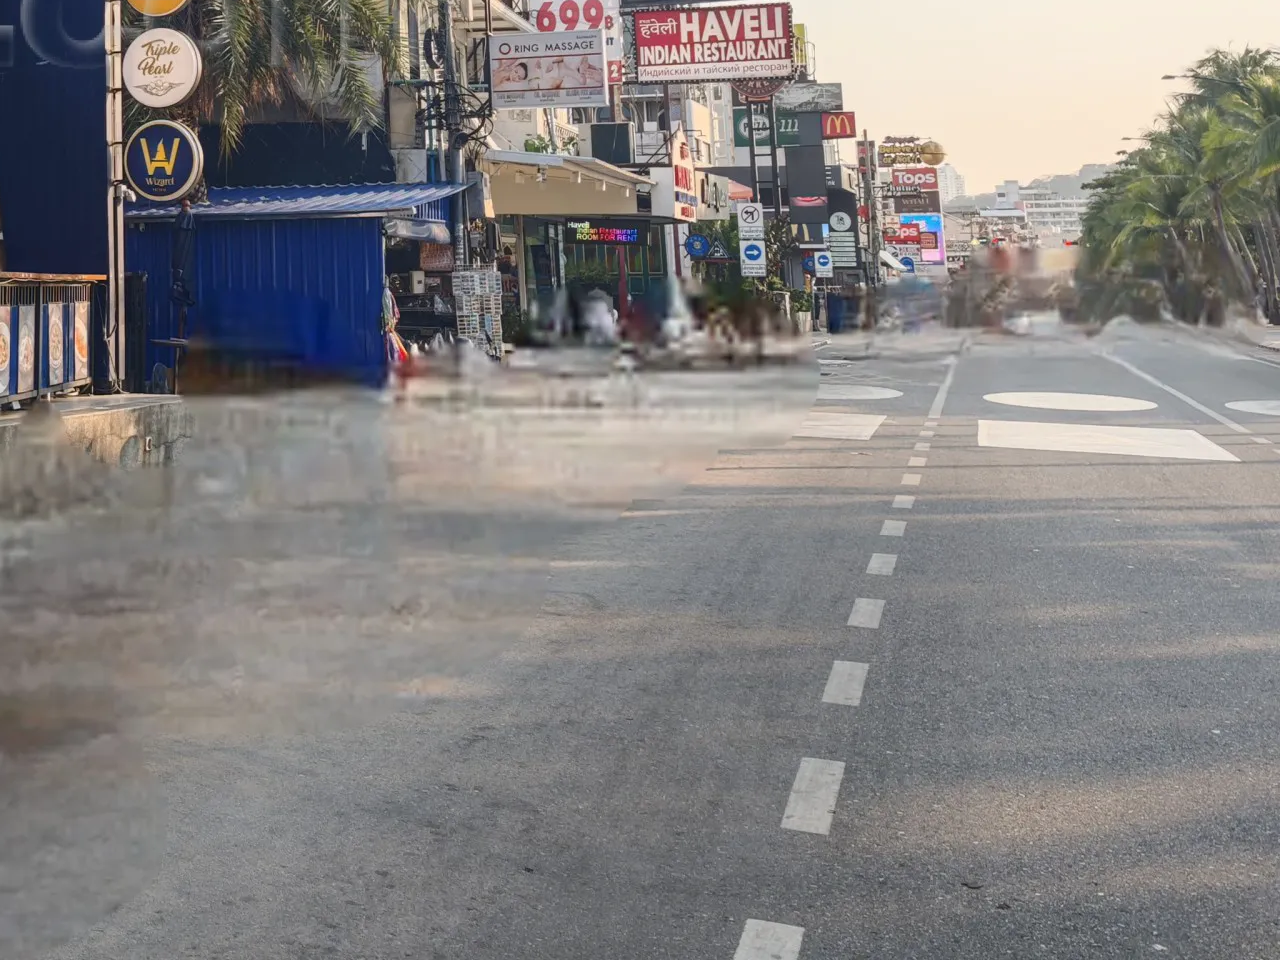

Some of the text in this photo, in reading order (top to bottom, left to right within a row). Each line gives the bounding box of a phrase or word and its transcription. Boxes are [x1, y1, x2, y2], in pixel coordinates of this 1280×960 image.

[639, 18, 679, 38] हवेली
[679, 6, 784, 43] HAVELI
[141, 39, 181, 61] Triple
[514, 43, 539, 53] RING
[545, 41, 594, 52] MASSAGE
[640, 39, 787, 65] INDIAN RESTAURANT
[137, 56, 174, 76] Pearl
[640, 66, 692, 77] Индийский
[702, 64, 741, 74] тайский
[742, 63, 789, 75] ресторан
[894, 171, 936, 185] Tops
[600, 233, 616, 241] FOR
